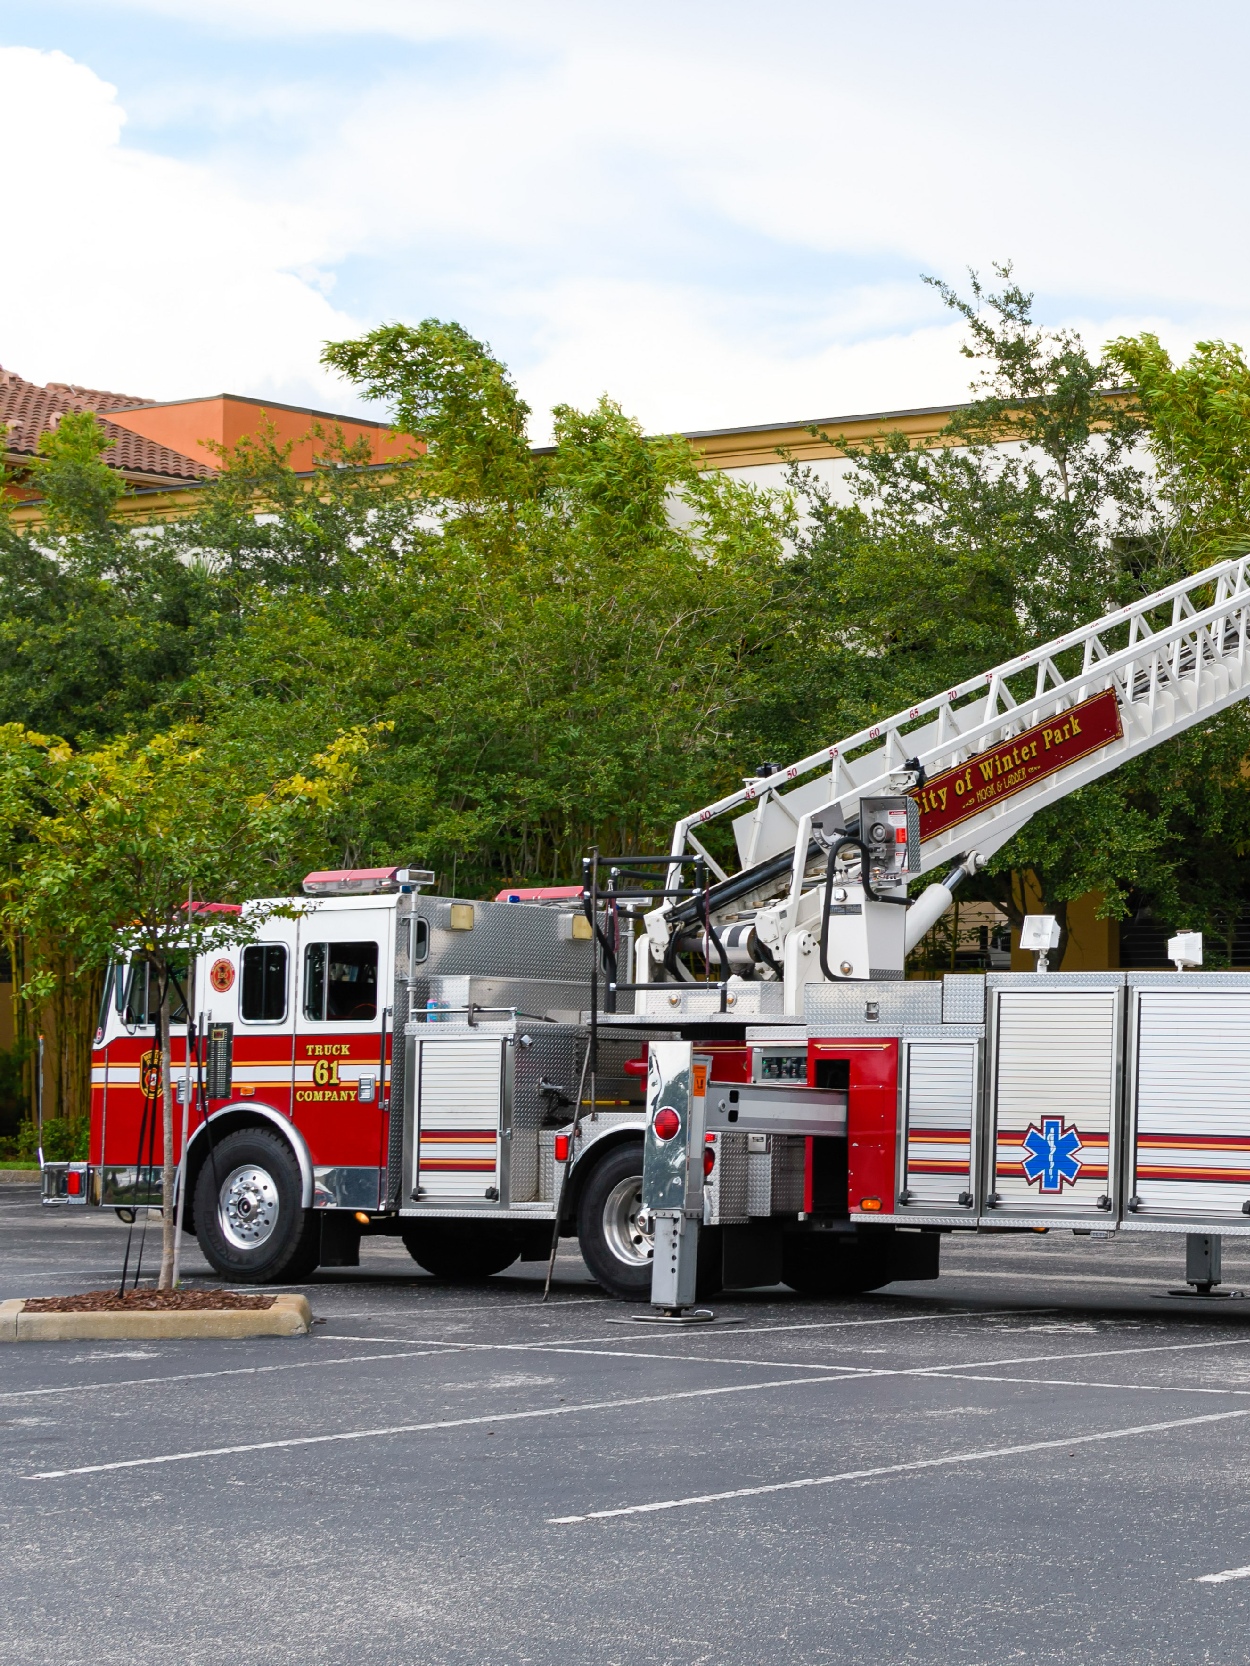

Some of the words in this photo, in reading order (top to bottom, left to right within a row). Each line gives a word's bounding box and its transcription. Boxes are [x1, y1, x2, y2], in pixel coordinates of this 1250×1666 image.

[947, 690, 957, 701] 70
[909, 708, 919, 719] 65
[869, 727, 880, 739] 60
[829, 747, 839, 759] 55
[955, 767, 973, 797] of
[979, 740, 1038, 782] Winter
[1042, 714, 1082, 750] Park
[787, 767, 798, 780] 50
[1003, 767, 1027, 788] LADDER
[306, 1044, 351, 1056] TRUCK
[314, 1059, 340, 1086] 61
[295, 1090, 358, 1102] COMPANY
